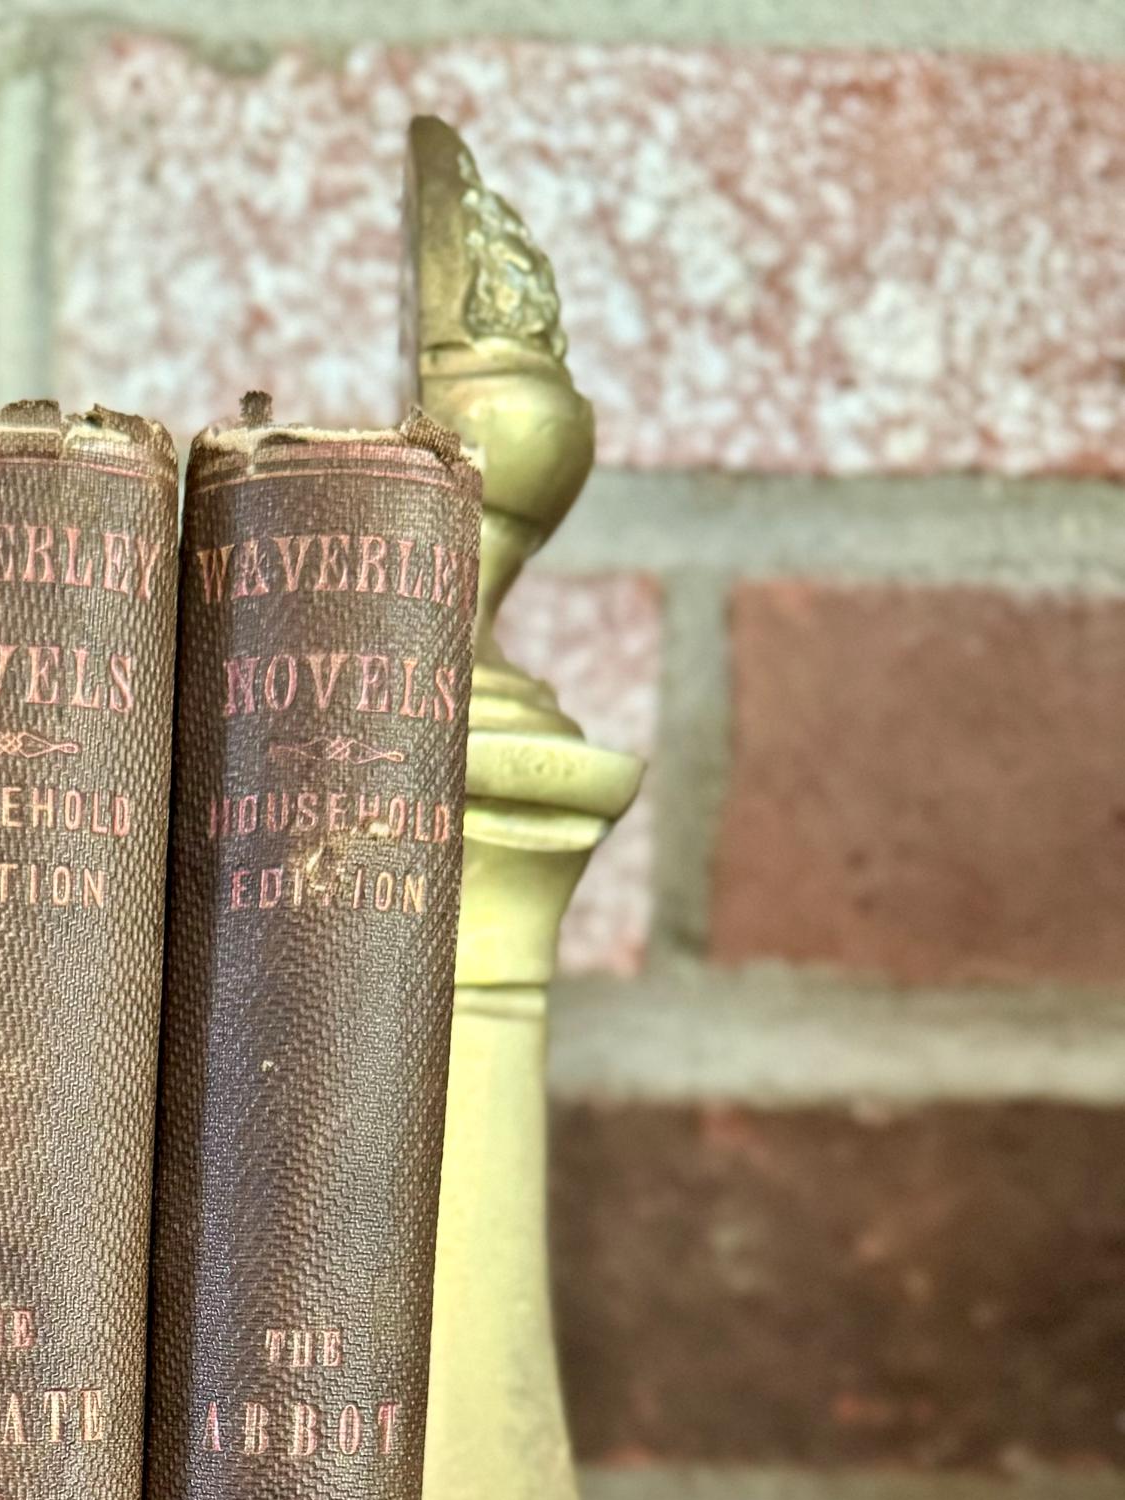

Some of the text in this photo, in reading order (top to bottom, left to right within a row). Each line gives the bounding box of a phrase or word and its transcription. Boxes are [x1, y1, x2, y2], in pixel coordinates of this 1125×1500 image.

[223, 653, 457, 722] NOVELS
[209, 792, 451, 844] HOUSEHOLD
[265, 1328, 342, 1367] THE
[202, 1400, 400, 1456] ABBOT
